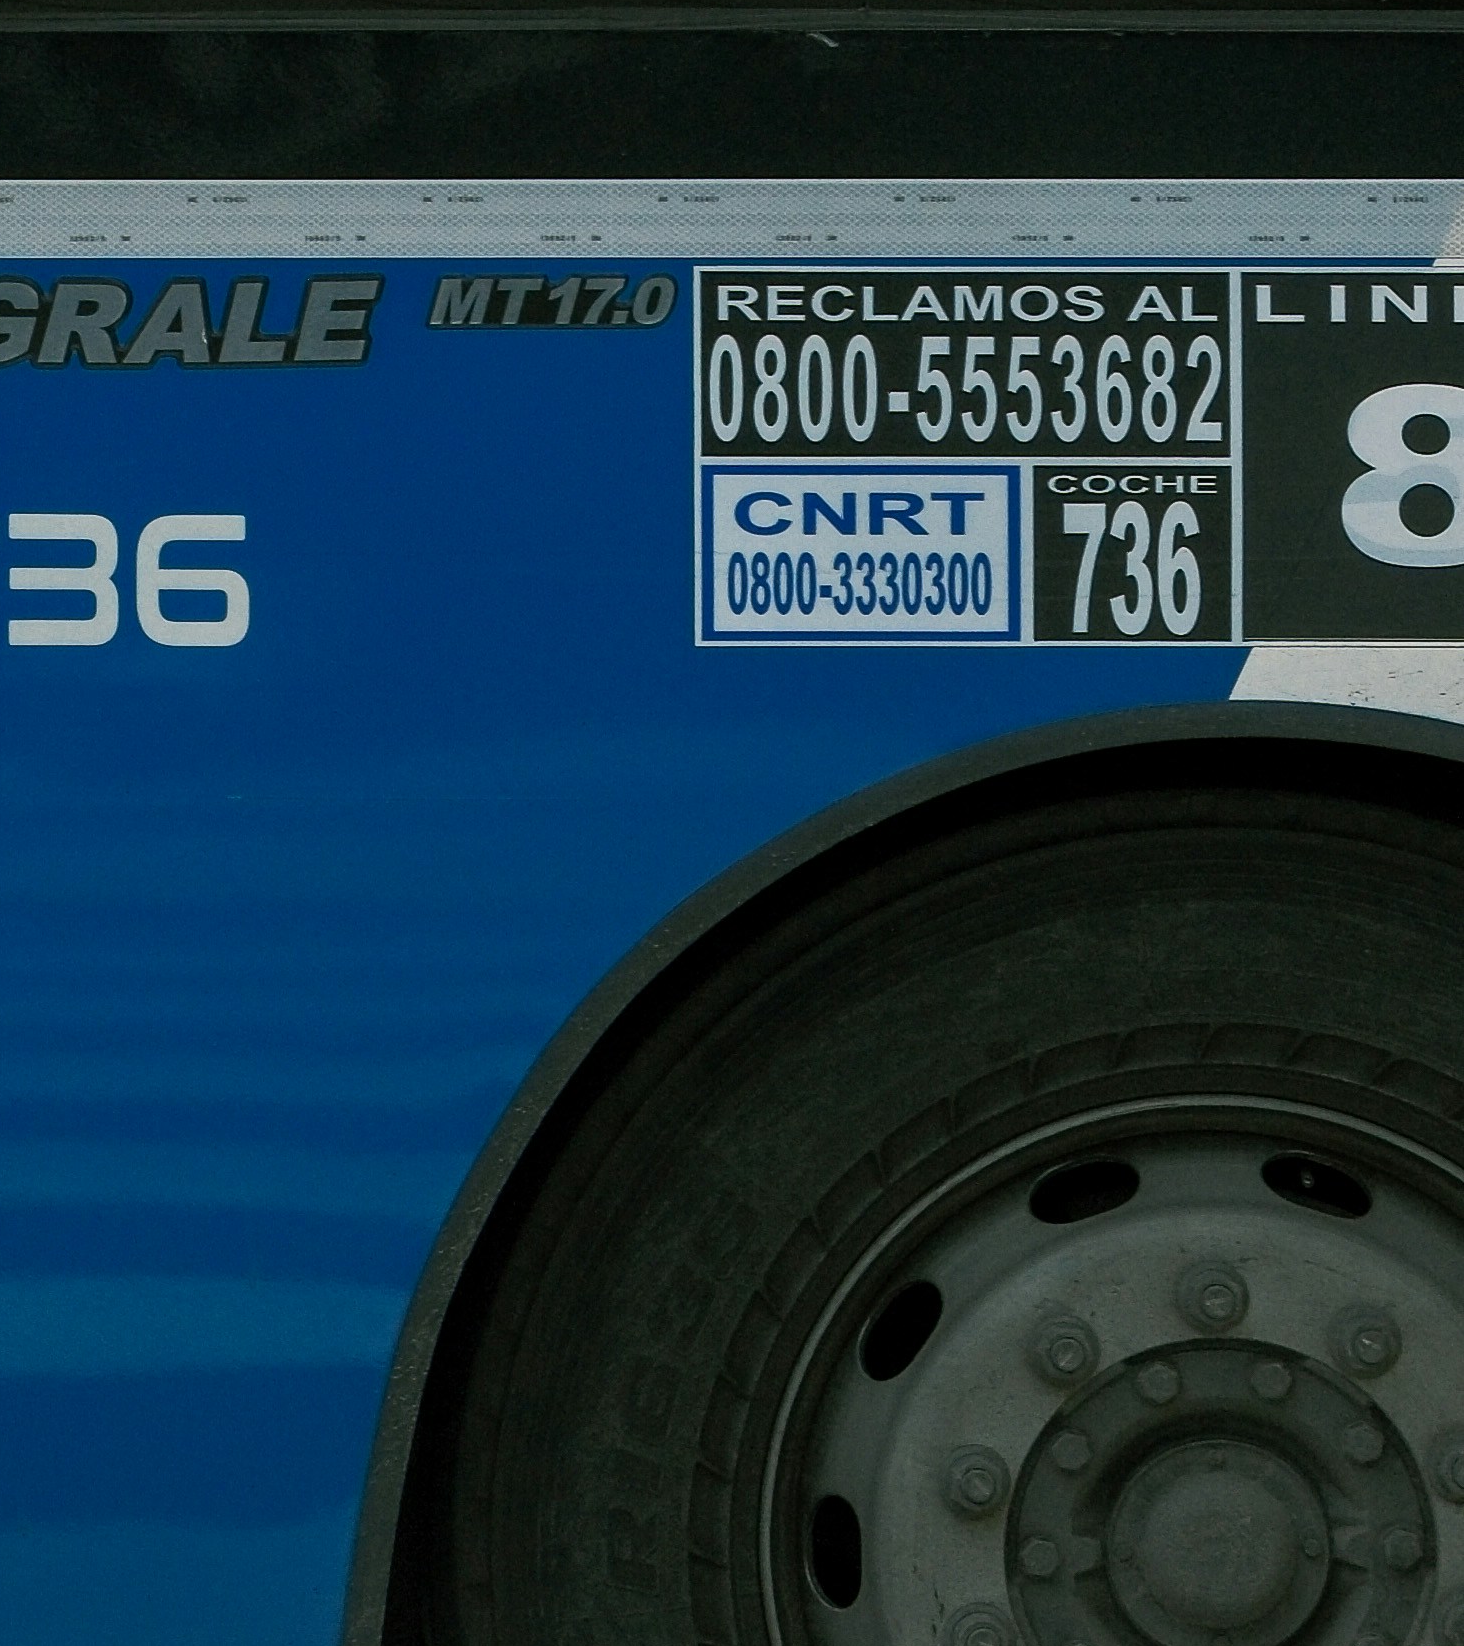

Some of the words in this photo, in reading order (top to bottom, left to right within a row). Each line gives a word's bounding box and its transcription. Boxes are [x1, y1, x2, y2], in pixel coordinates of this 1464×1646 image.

[716, 285, 1104, 322] RECLAMOS
[1127, 285, 1219, 322] AL
[1256, 285, 1464, 323] LIN
[709, 334, 1223, 442] 0800-5553682
[1047, 474, 1218, 494] COCHE
[734, 492, 985, 536] CNRT
[727, 552, 993, 616] 0800-3330300
[1063, 501, 1202, 636] 736
